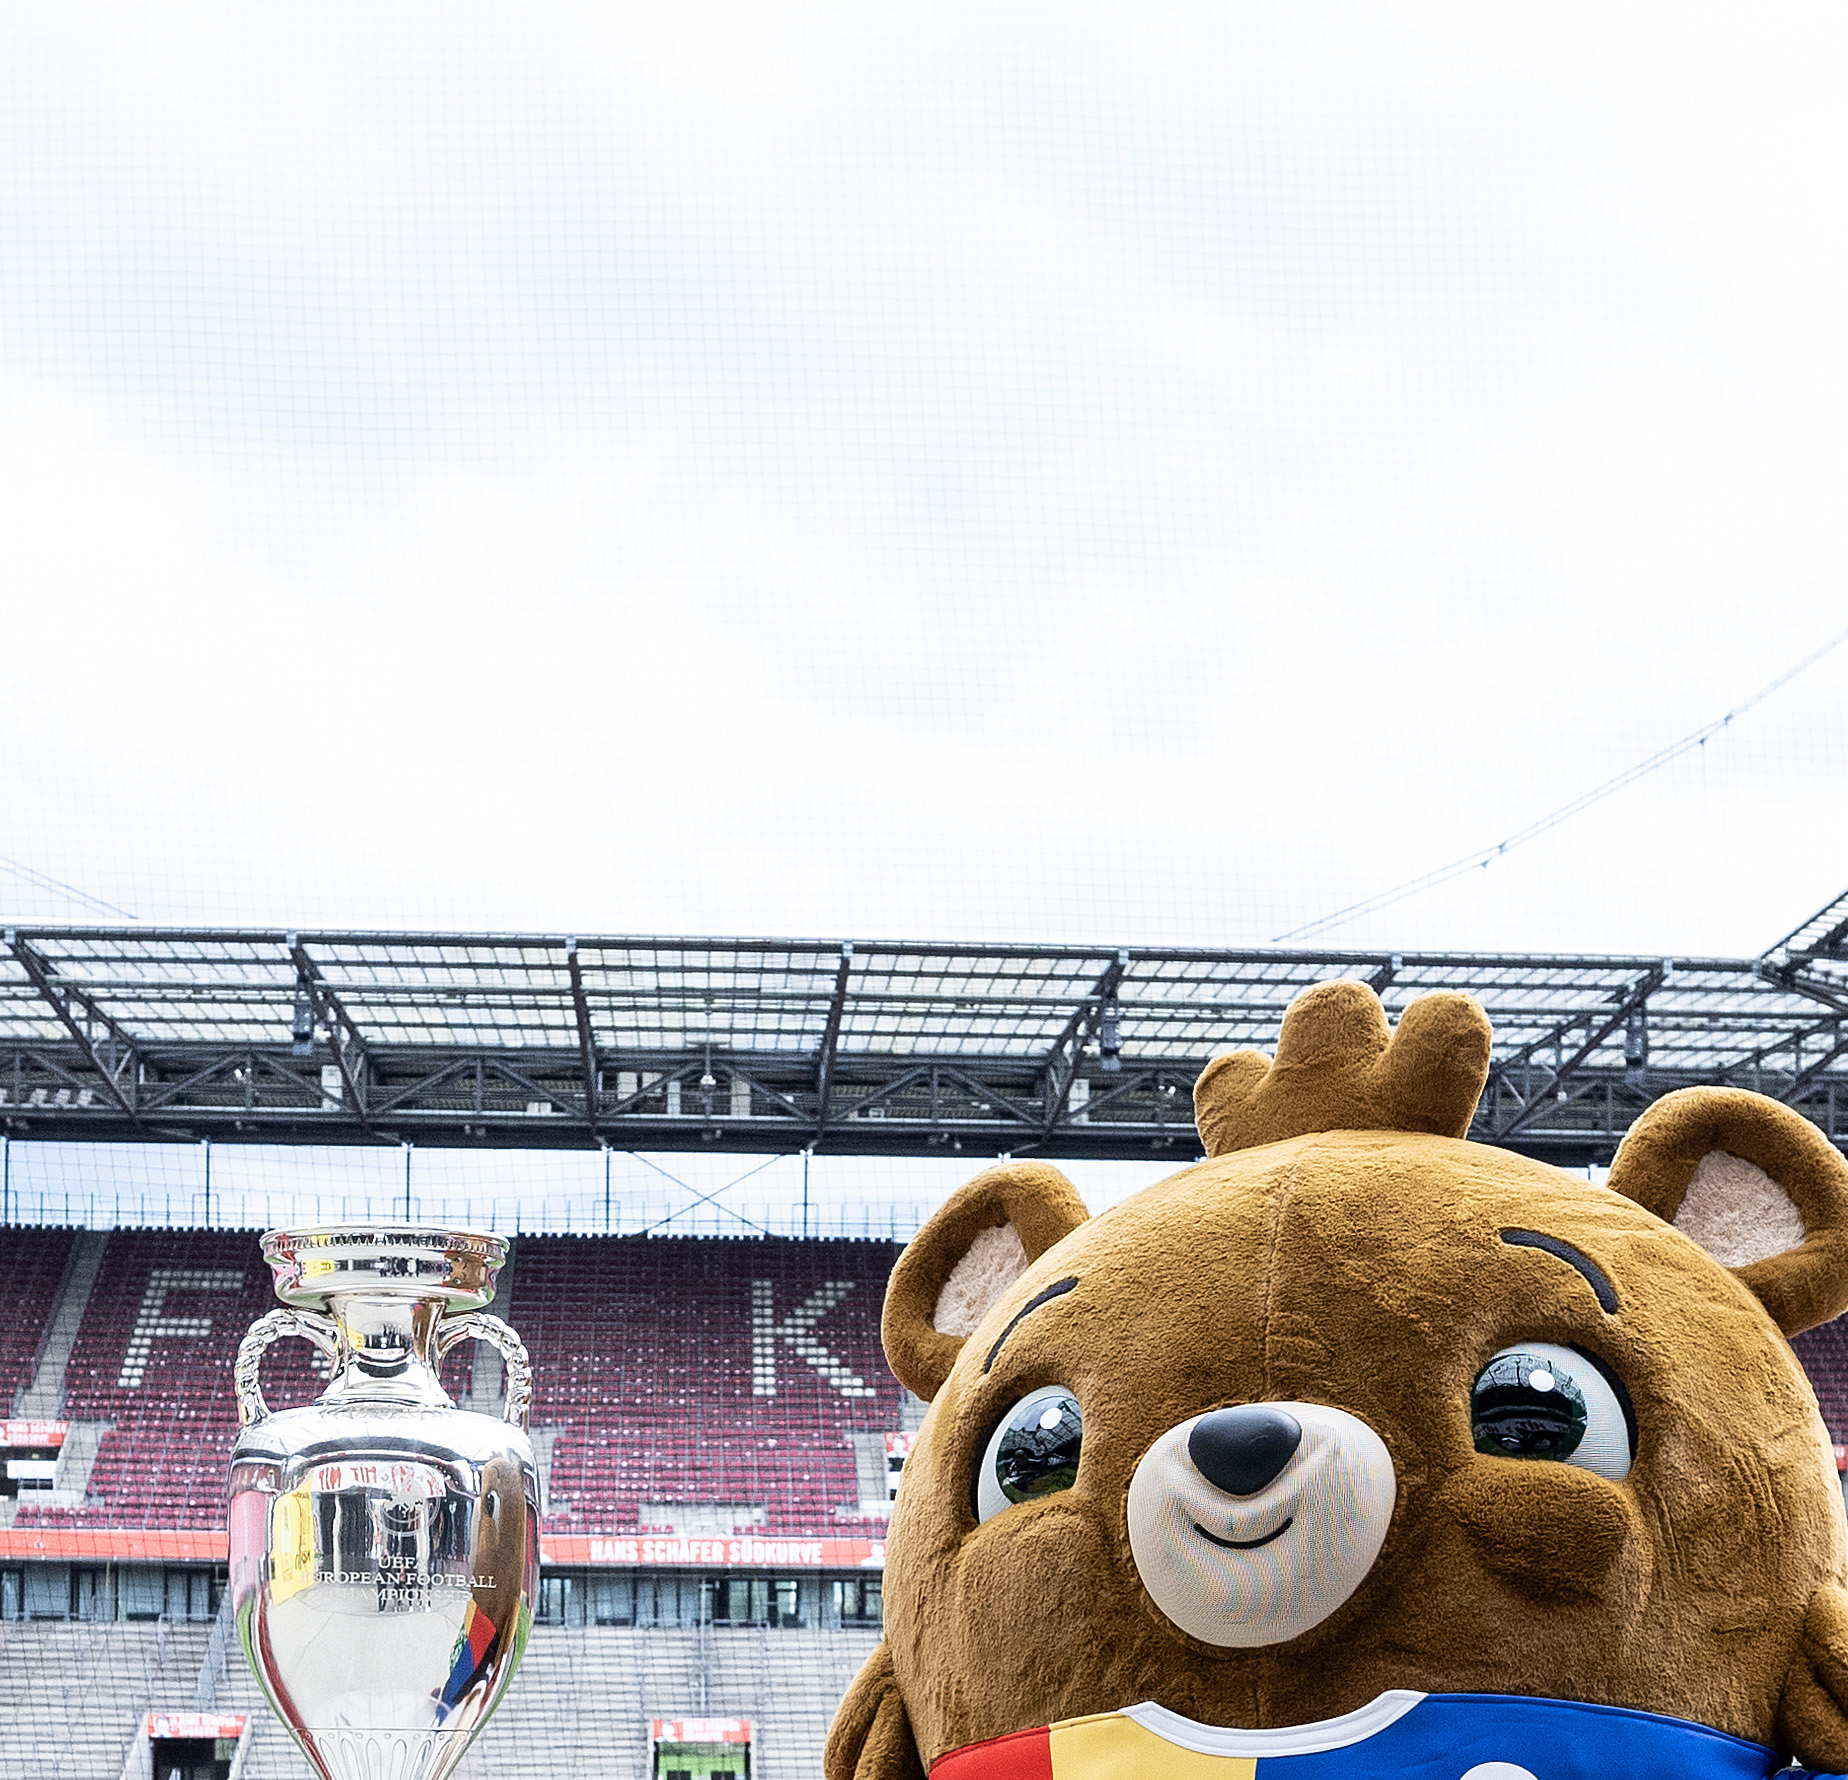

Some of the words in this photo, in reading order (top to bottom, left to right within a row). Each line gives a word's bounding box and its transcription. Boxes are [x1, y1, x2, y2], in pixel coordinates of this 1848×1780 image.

[591, 1540, 638, 1562] HANS
[642, 1537, 724, 1563] SCHÄFER
[729, 1538, 823, 1564] SÜDKURVE
[378, 1556, 427, 1569] UEFA
[308, 1571, 400, 1585] UROPEAN
[405, 1572, 497, 1588] FOOTBALL
